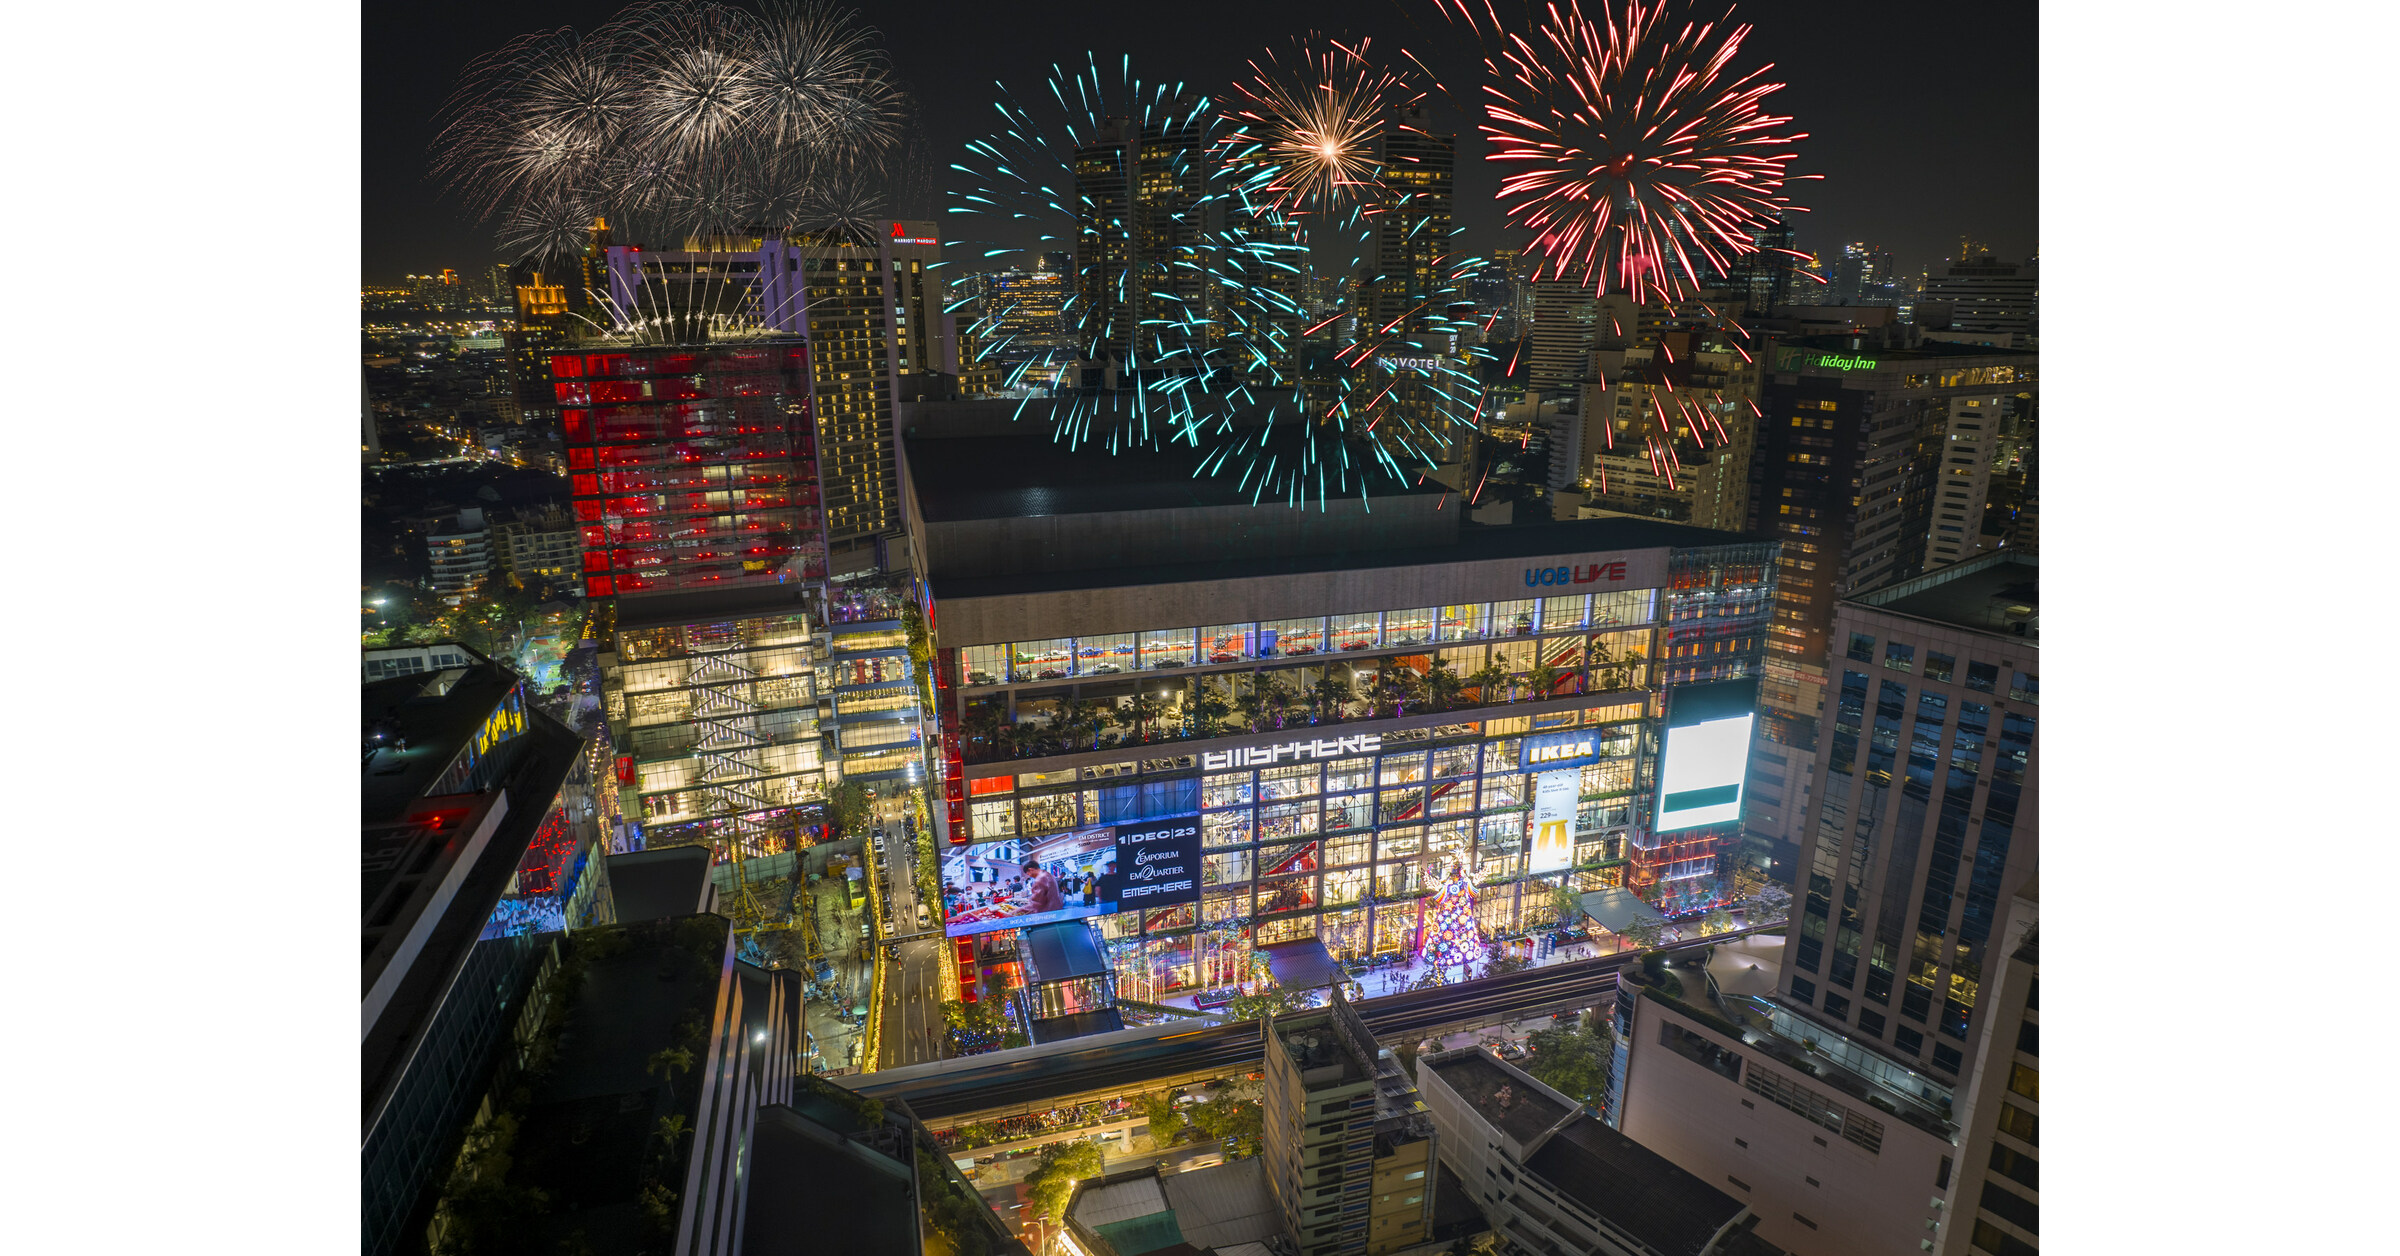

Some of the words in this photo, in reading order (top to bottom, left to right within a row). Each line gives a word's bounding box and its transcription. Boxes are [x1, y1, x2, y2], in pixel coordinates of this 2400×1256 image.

[1378, 357, 1440, 370] NOVOTEL
[1805, 354, 1854, 371] Holiday
[1854, 355, 1877, 370] Inn
[1525, 566, 1570, 588] UOB
[1573, 561, 1628, 585] LIVE
[1203, 734, 1383, 771] EMSPHERE
[1529, 741, 1594, 765] IKEA
[1129, 864, 1185, 882] EMQUARTIER
[1122, 879, 1193, 899] EMSPHERE
